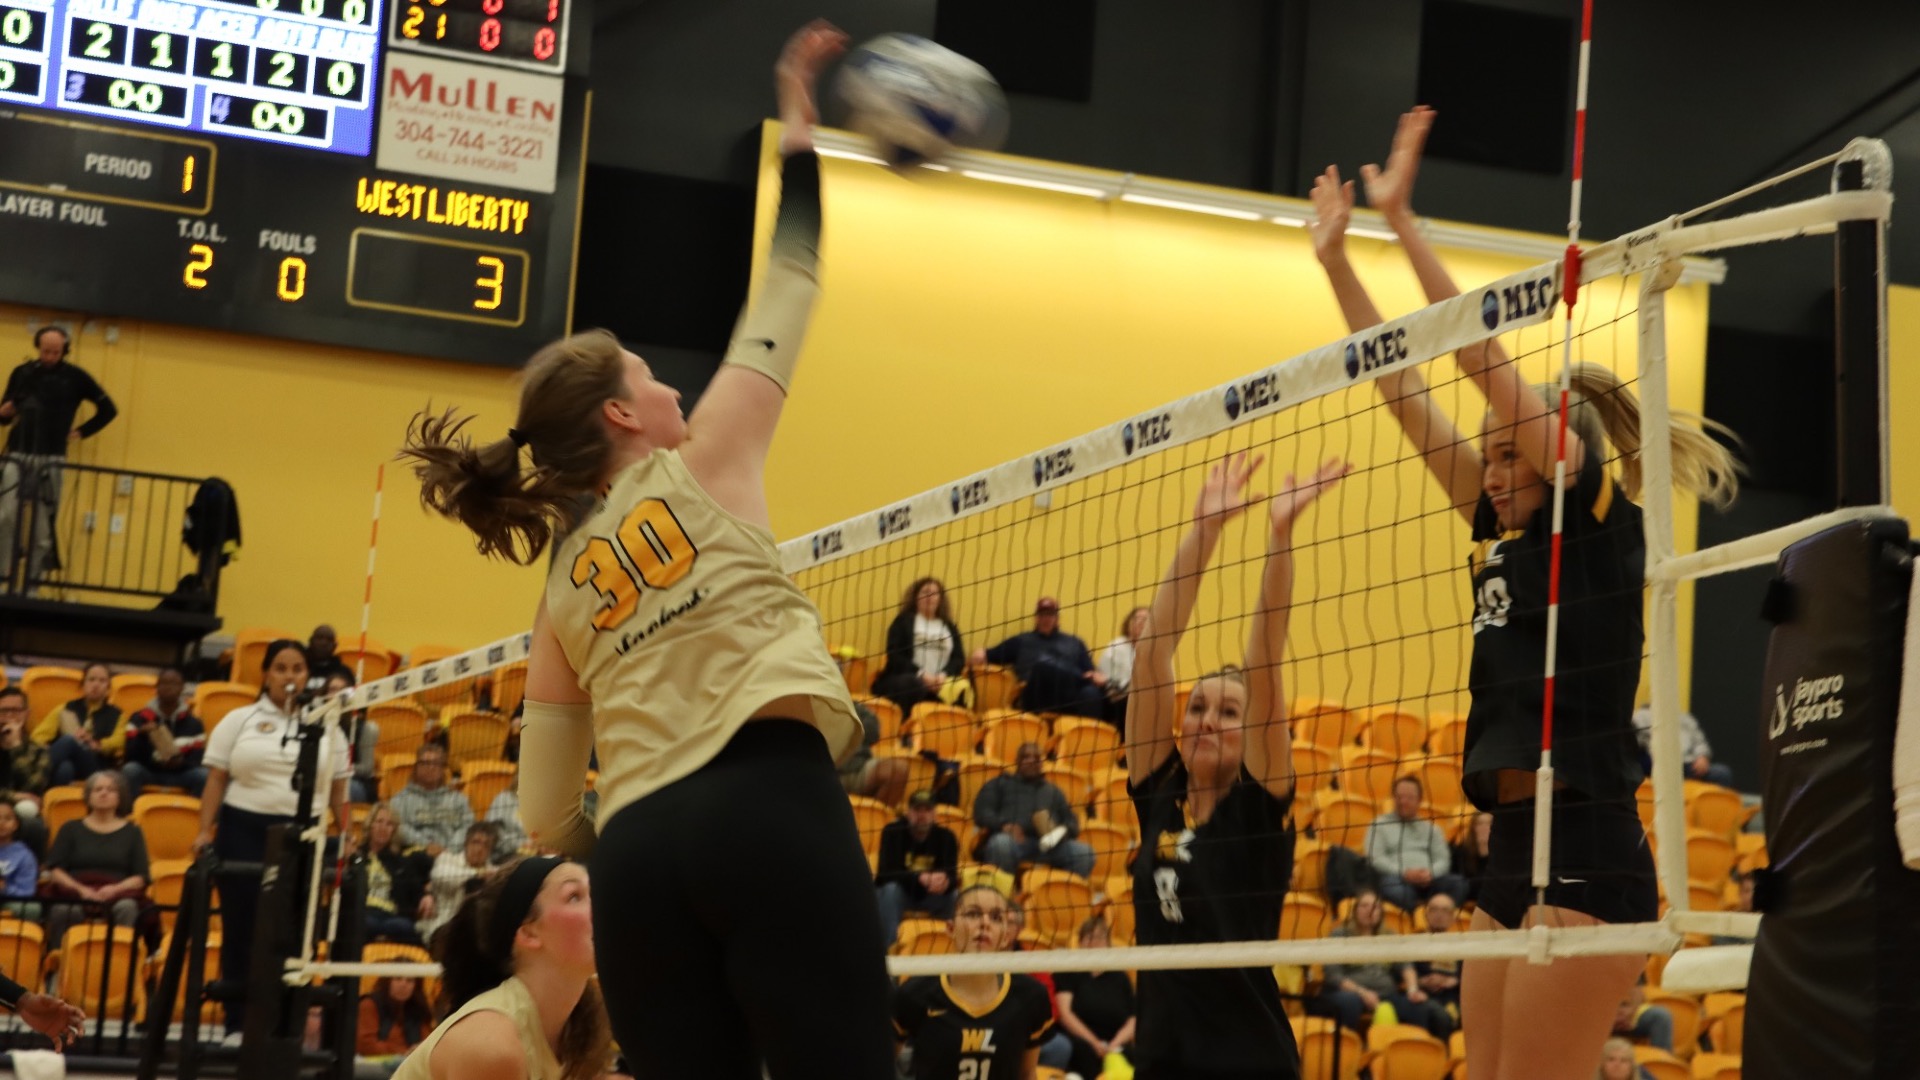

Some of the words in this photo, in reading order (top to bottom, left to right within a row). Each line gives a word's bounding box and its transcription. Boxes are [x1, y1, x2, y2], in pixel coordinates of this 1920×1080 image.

[2, 9, 33, 45] 0
[402, 5, 447, 40] 21
[480, 18, 501, 51] 0
[533, 27, 555, 61] 0
[84, 22, 113, 58] 2
[150, 33, 172, 68] 1
[210, 42, 233, 78] 1
[267, 52, 296, 87] 2
[327, 61, 356, 96] 0
[108, 79, 163, 112] 00
[252, 102, 305, 133] 00
[395, 119, 544, 161] 304-744-3221
[85, 152, 153, 180] PERIOD
[182, 155, 195, 193] 1
[416, 148, 449, 165] CALL
[471, 155, 519, 174] HOURS
[59, 201, 108, 227] FOUL
[357, 177, 427, 220] WEST
[427, 187, 529, 235] LIBERTY
[177, 218, 228, 243] T.O.L.
[259, 229, 318, 254] FOULS
[183, 244, 213, 289] 2
[277, 256, 307, 302] 0
[474, 255, 505, 310] 3
[1502, 276, 1553, 321] MEC
[1361, 326, 1409, 373] MEC
[1242, 374, 1281, 414] MEC
[1136, 412, 1172, 449] MEC
[1044, 447, 1076, 482] MEC
[570, 496, 699, 633] 30
[1792, 696, 1844, 732] sports
[961, 1028, 997, 1053] WL
[958, 1058, 992, 1080] 21
